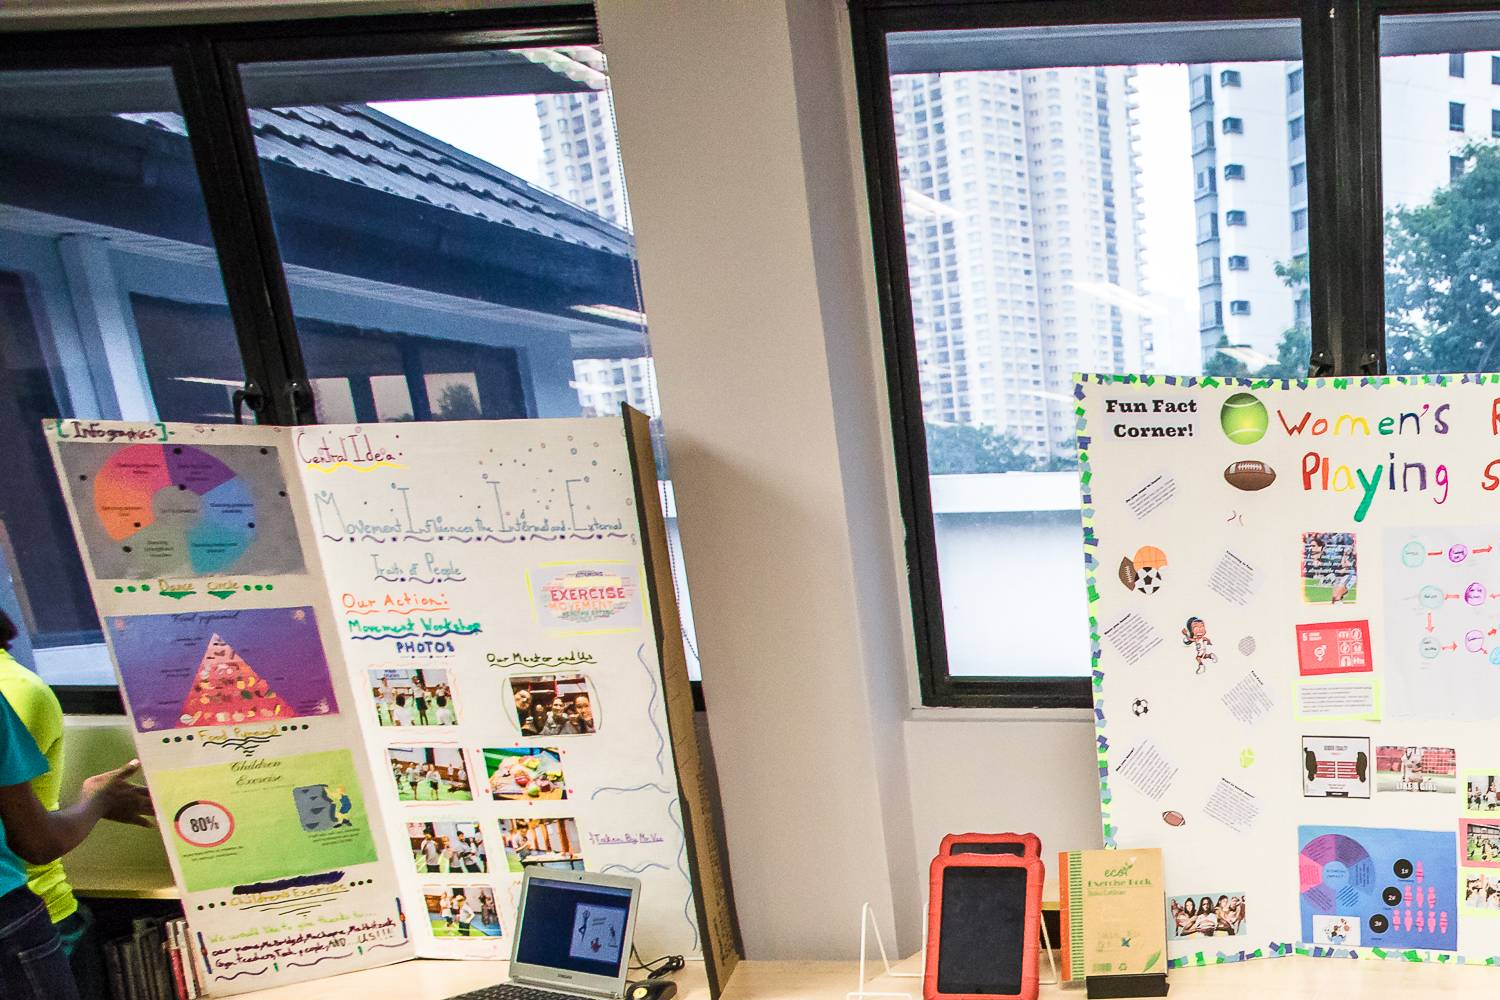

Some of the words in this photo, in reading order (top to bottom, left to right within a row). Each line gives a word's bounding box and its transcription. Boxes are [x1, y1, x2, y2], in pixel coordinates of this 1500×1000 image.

[1105, 399, 1147, 413] Fun
[1152, 399, 1197, 413] Fact
[1277, 403, 1450, 437] Women's
[1113, 423, 1193, 437] Corner!
[297, 432, 348, 463] Central
[1302, 452, 1450, 522] Playing
[342, 593, 376, 608] Our
[550, 587, 625, 601] EXERCISE
[396, 641, 455, 653] PHOTOS
[486, 653, 509, 662] Our
[230, 758, 281, 772] Children
[190, 816, 219, 833] 80%
